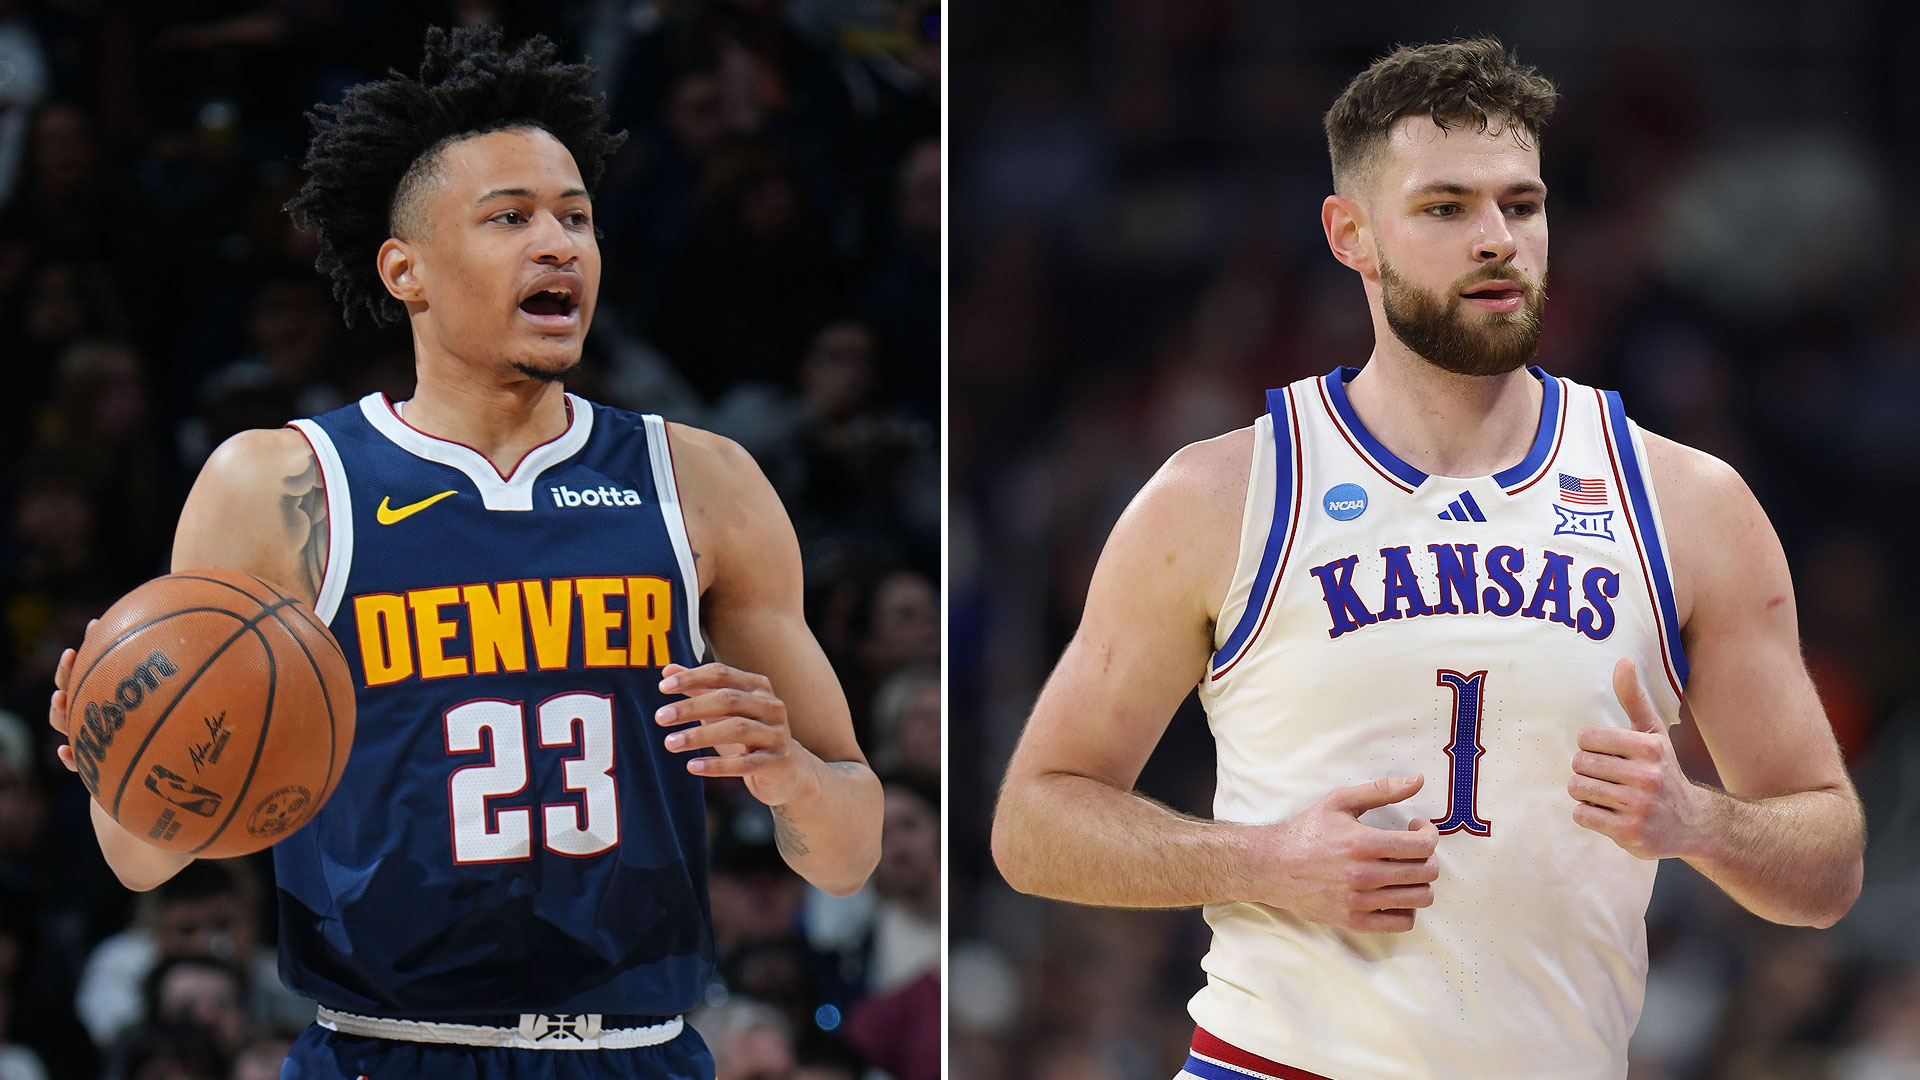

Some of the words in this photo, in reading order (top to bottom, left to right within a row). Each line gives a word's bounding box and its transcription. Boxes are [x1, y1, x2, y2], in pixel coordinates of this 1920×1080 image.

[552, 486, 642, 508] ibotta
[1329, 499, 1365, 511] NCAA
[353, 576, 672, 687] DENVER
[1310, 544, 1620, 641] KANSAS
[442, 690, 621, 866] 23
[1430, 668, 1492, 837] 1
